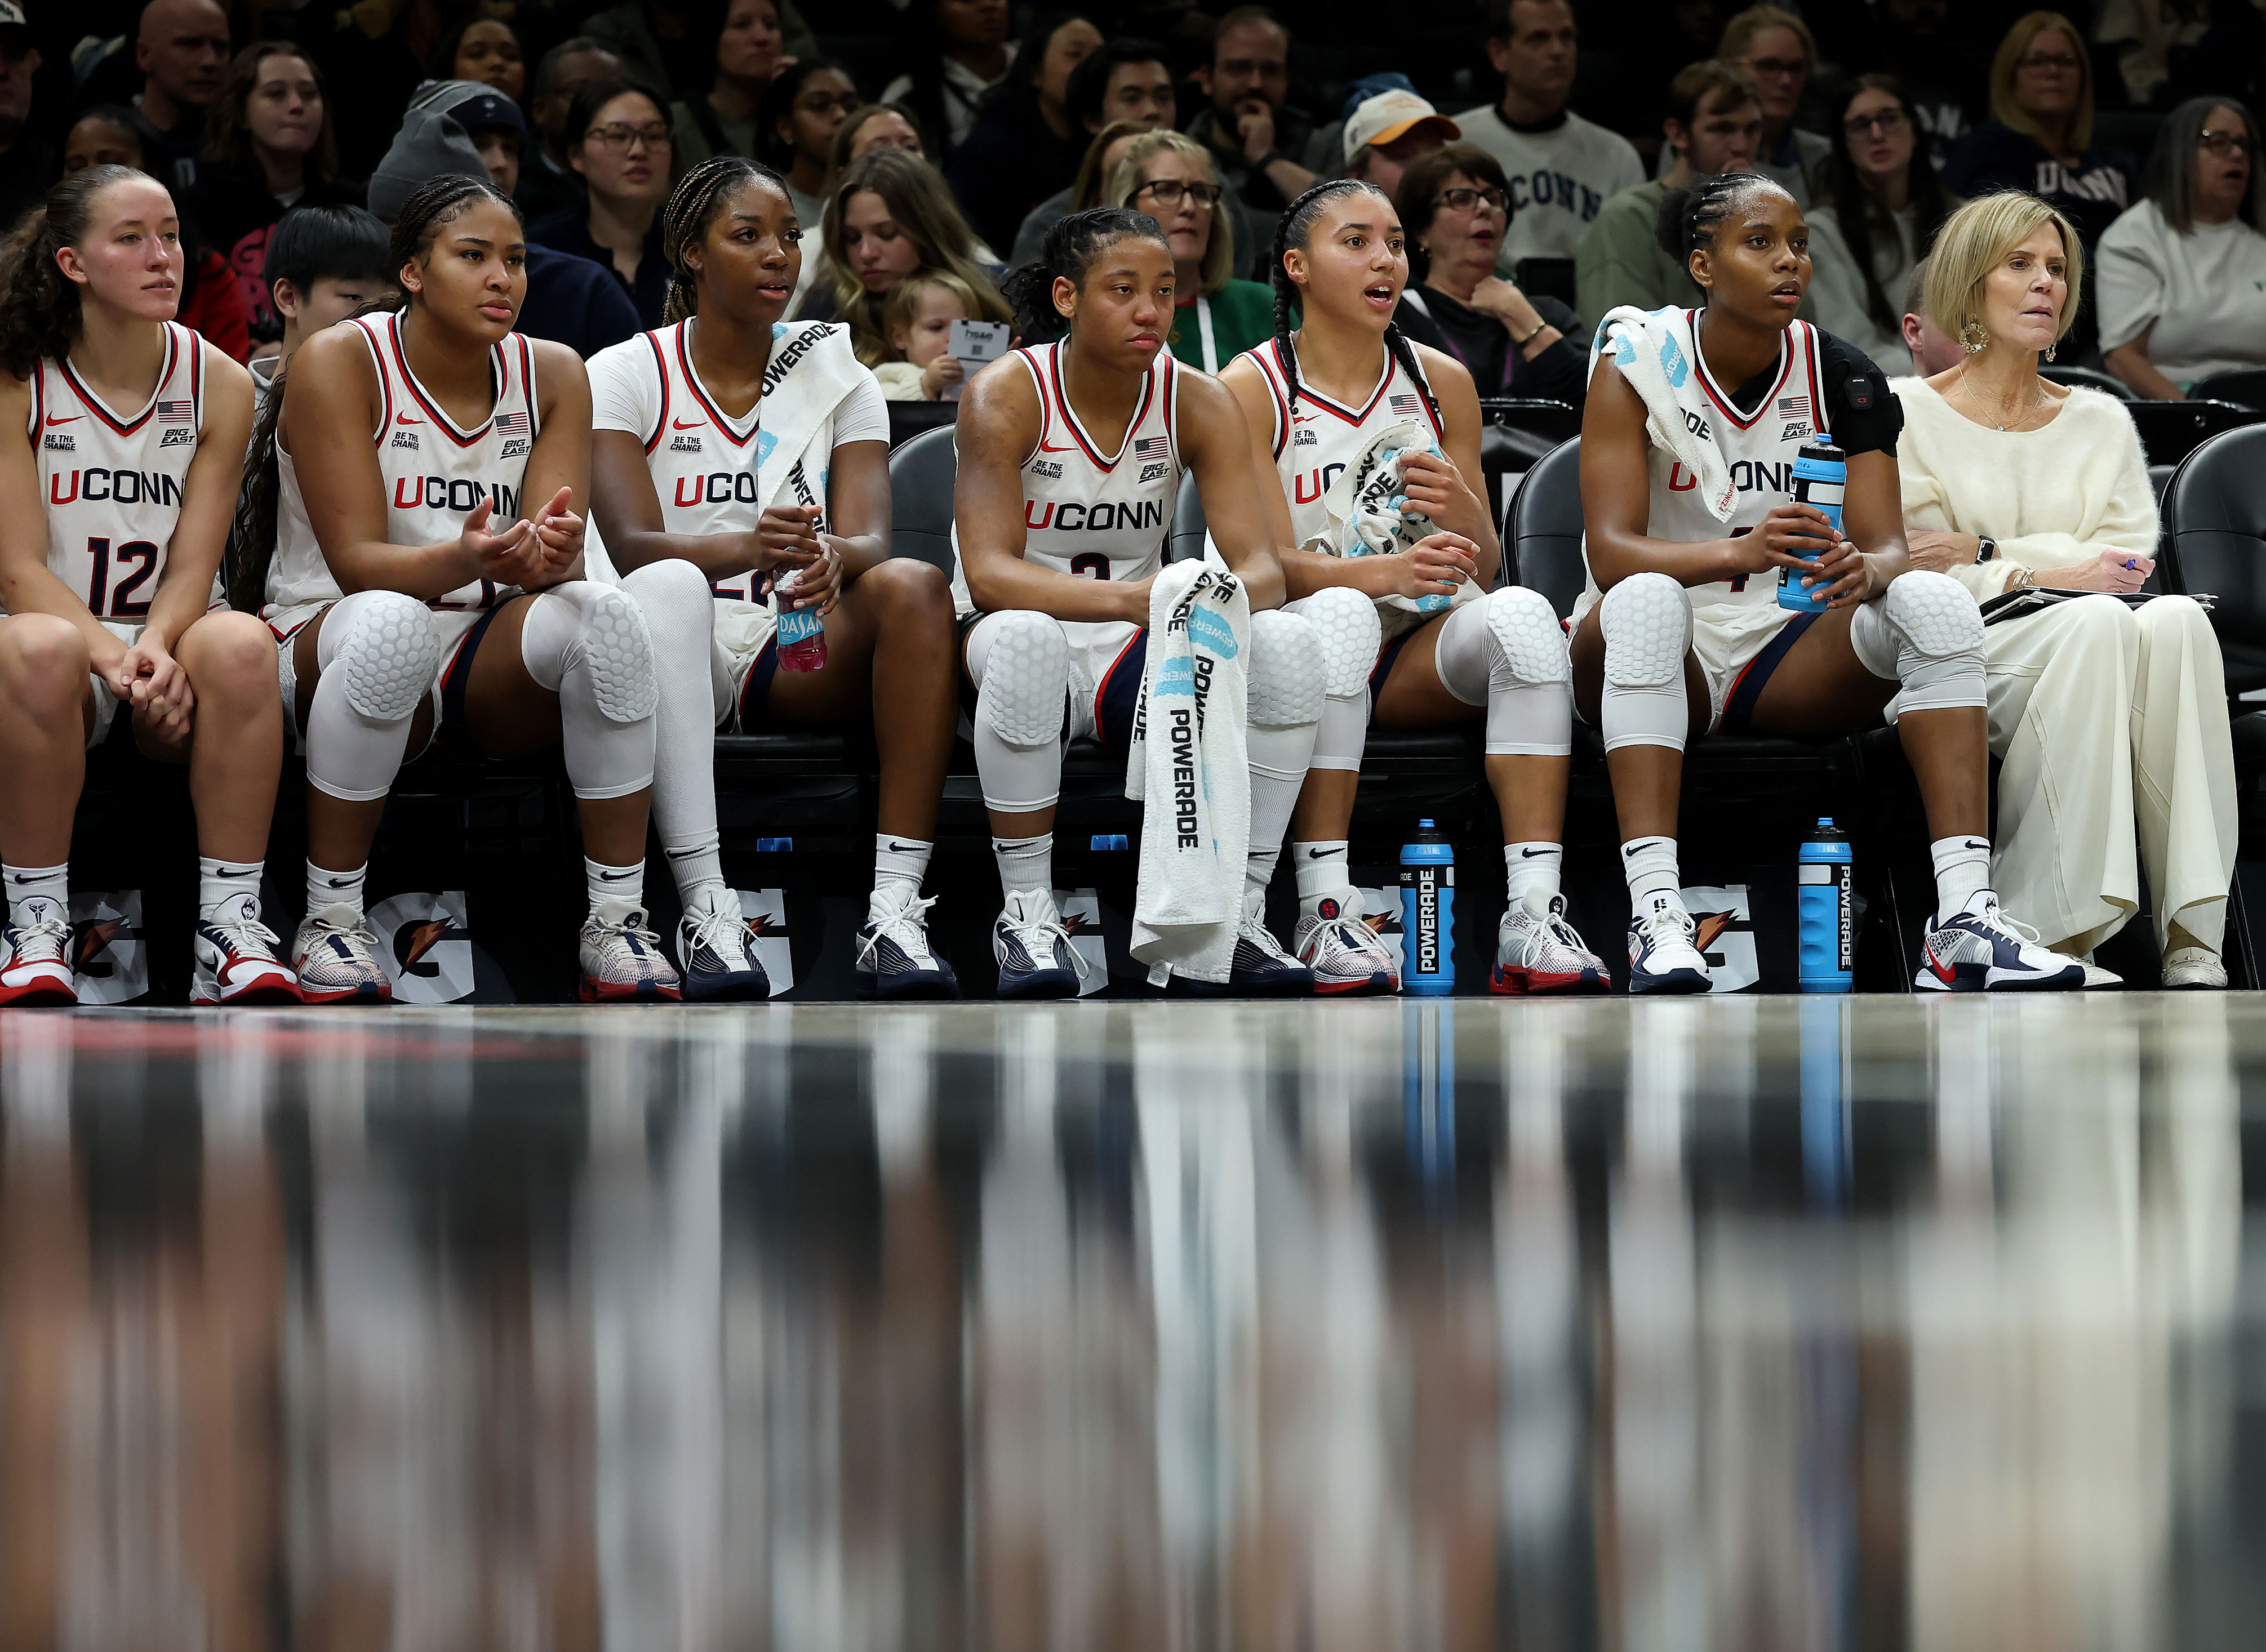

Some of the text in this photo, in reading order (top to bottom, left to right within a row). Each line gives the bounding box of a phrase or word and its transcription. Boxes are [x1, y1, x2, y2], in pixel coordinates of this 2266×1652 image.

[1785, 421, 1807, 430] BIG
[45, 434, 56, 443] BE
[165, 428, 189, 437] BIG
[395, 431, 419, 443] BE THE
[1783, 428, 1812, 438] EAST
[45, 442, 76, 451] CHANGE
[392, 439, 419, 451] CHANGE
[504, 439, 526, 448] BIG
[670, 443, 702, 452] CHANGE
[501, 446, 531, 456] EAST
[1036, 459, 1063, 471] BE THE
[1143, 462, 1165, 473] BIG
[1031, 466, 1063, 479] CHANGE
[1140, 467, 1170, 480] EAST
[51, 467, 185, 508] UCONN
[674, 472, 758, 507] UCO
[394, 476, 519, 518] UCONN
[1025, 498, 1163, 531] UCONN
[88, 537, 158, 616] 12
